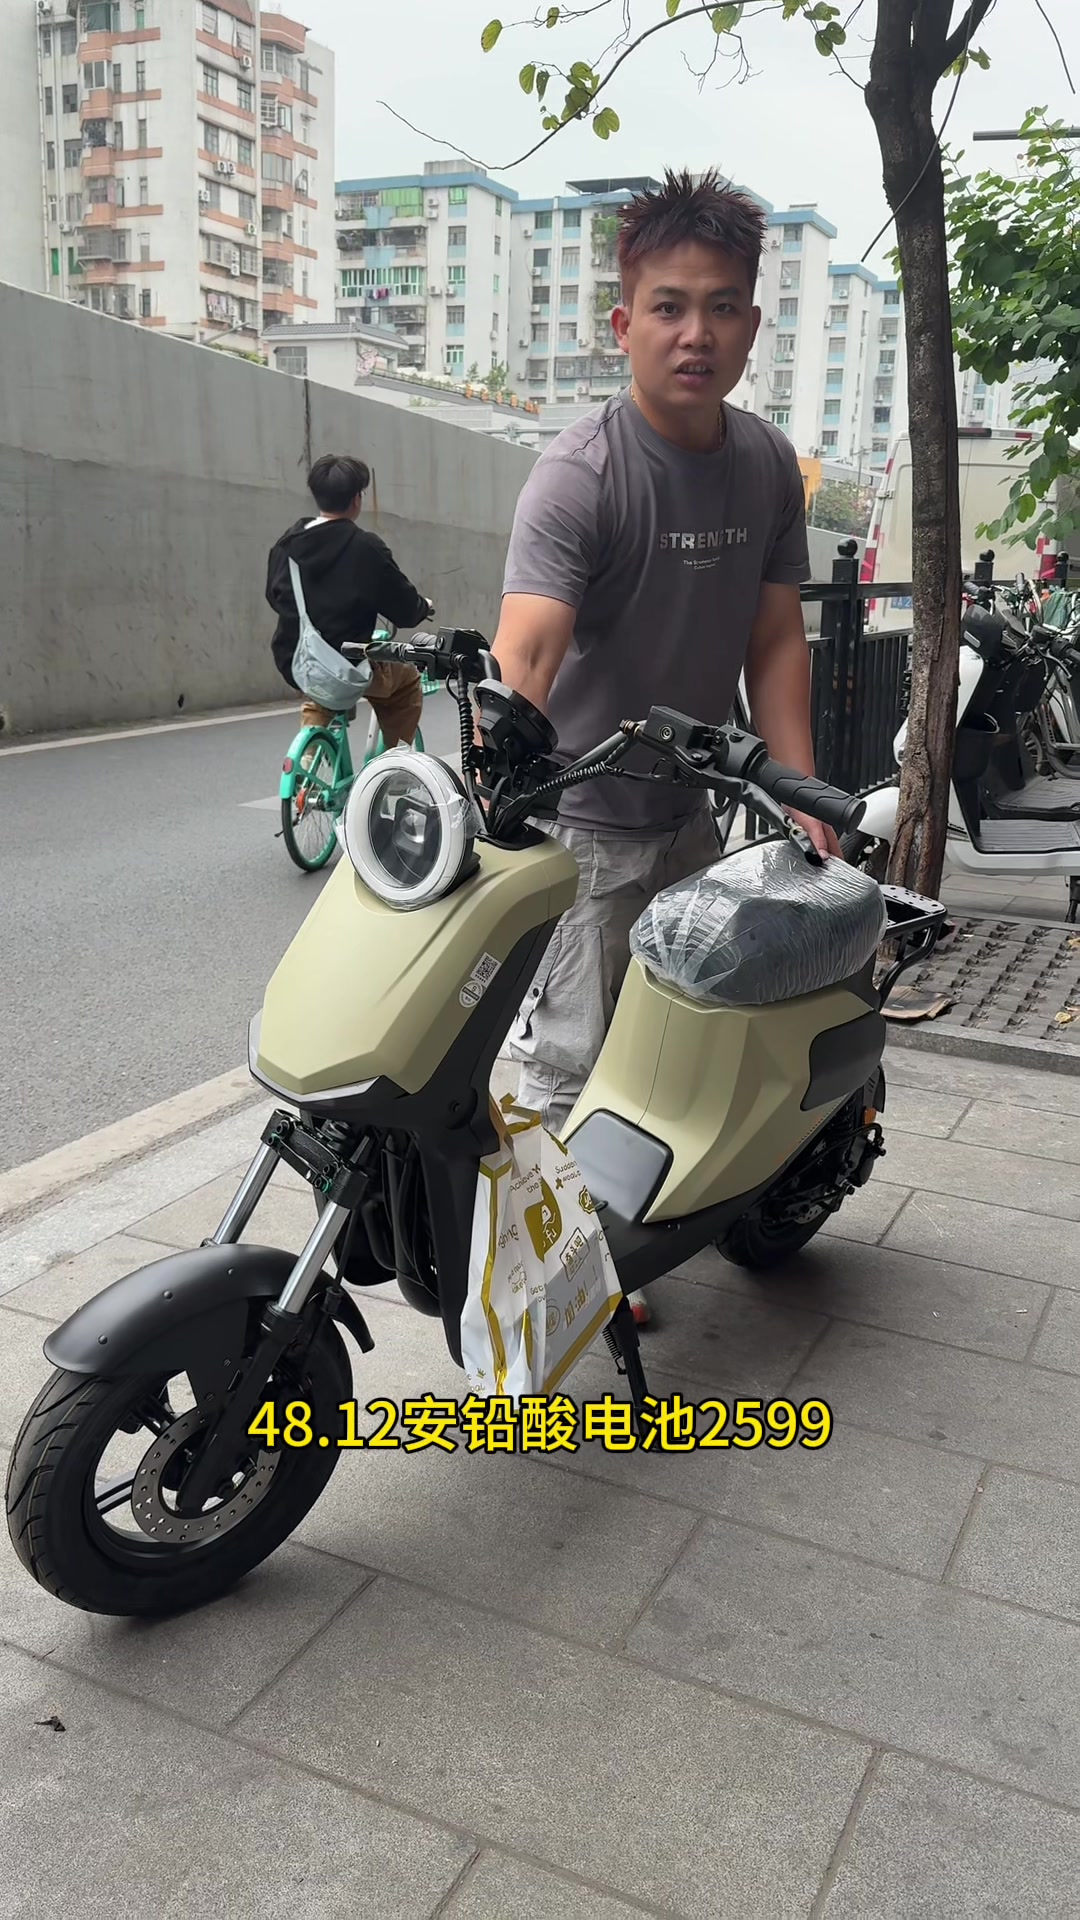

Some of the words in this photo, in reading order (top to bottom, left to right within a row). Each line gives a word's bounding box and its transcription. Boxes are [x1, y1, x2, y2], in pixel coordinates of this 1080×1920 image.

[555, 1161, 577, 1174] Sudden
[509, 1171, 534, 1192] Achieve
[562, 1170, 582, 1182] wealt
